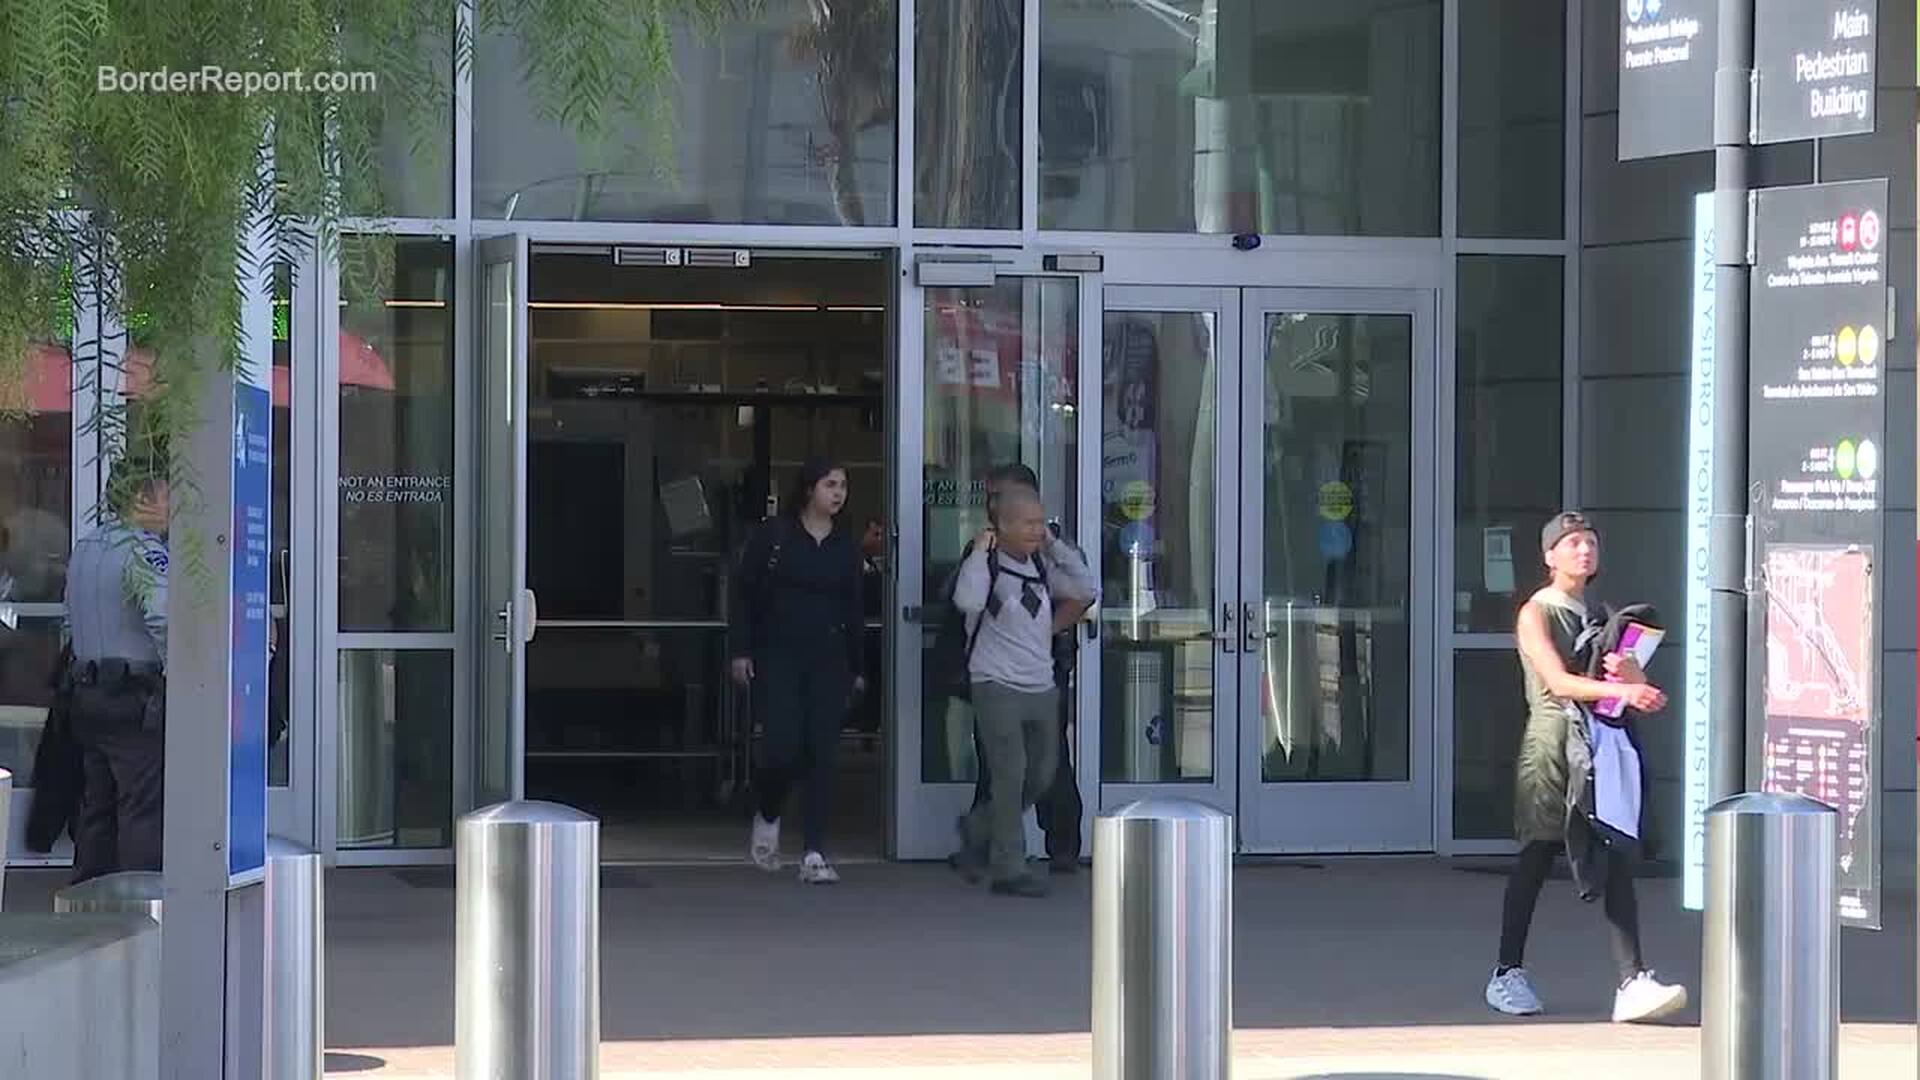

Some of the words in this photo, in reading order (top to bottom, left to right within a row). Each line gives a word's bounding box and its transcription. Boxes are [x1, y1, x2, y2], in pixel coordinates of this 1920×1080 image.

[1626, 22, 1670, 45] Pedestrian
[1670, 17, 1699, 40] Bridge
[1833, 9, 1869, 40] Main
[1626, 48, 1654, 69] Puente
[1796, 48, 1868, 83] Pedestrian
[1810, 86, 1867, 120] Building
[1702, 227, 1715, 292] SAN
[1699, 304, 1714, 427] YSIDRO
[338, 475, 364, 488] NOT
[366, 475, 384, 488] AN
[385, 475, 451, 488] ENTRANCE
[345, 490, 365, 502] NO
[366, 490, 383, 502] ES
[385, 490, 442, 502] ENTRADA
[1696, 448, 1711, 537] PORT
[1694, 603, 1709, 708] ENTRY
